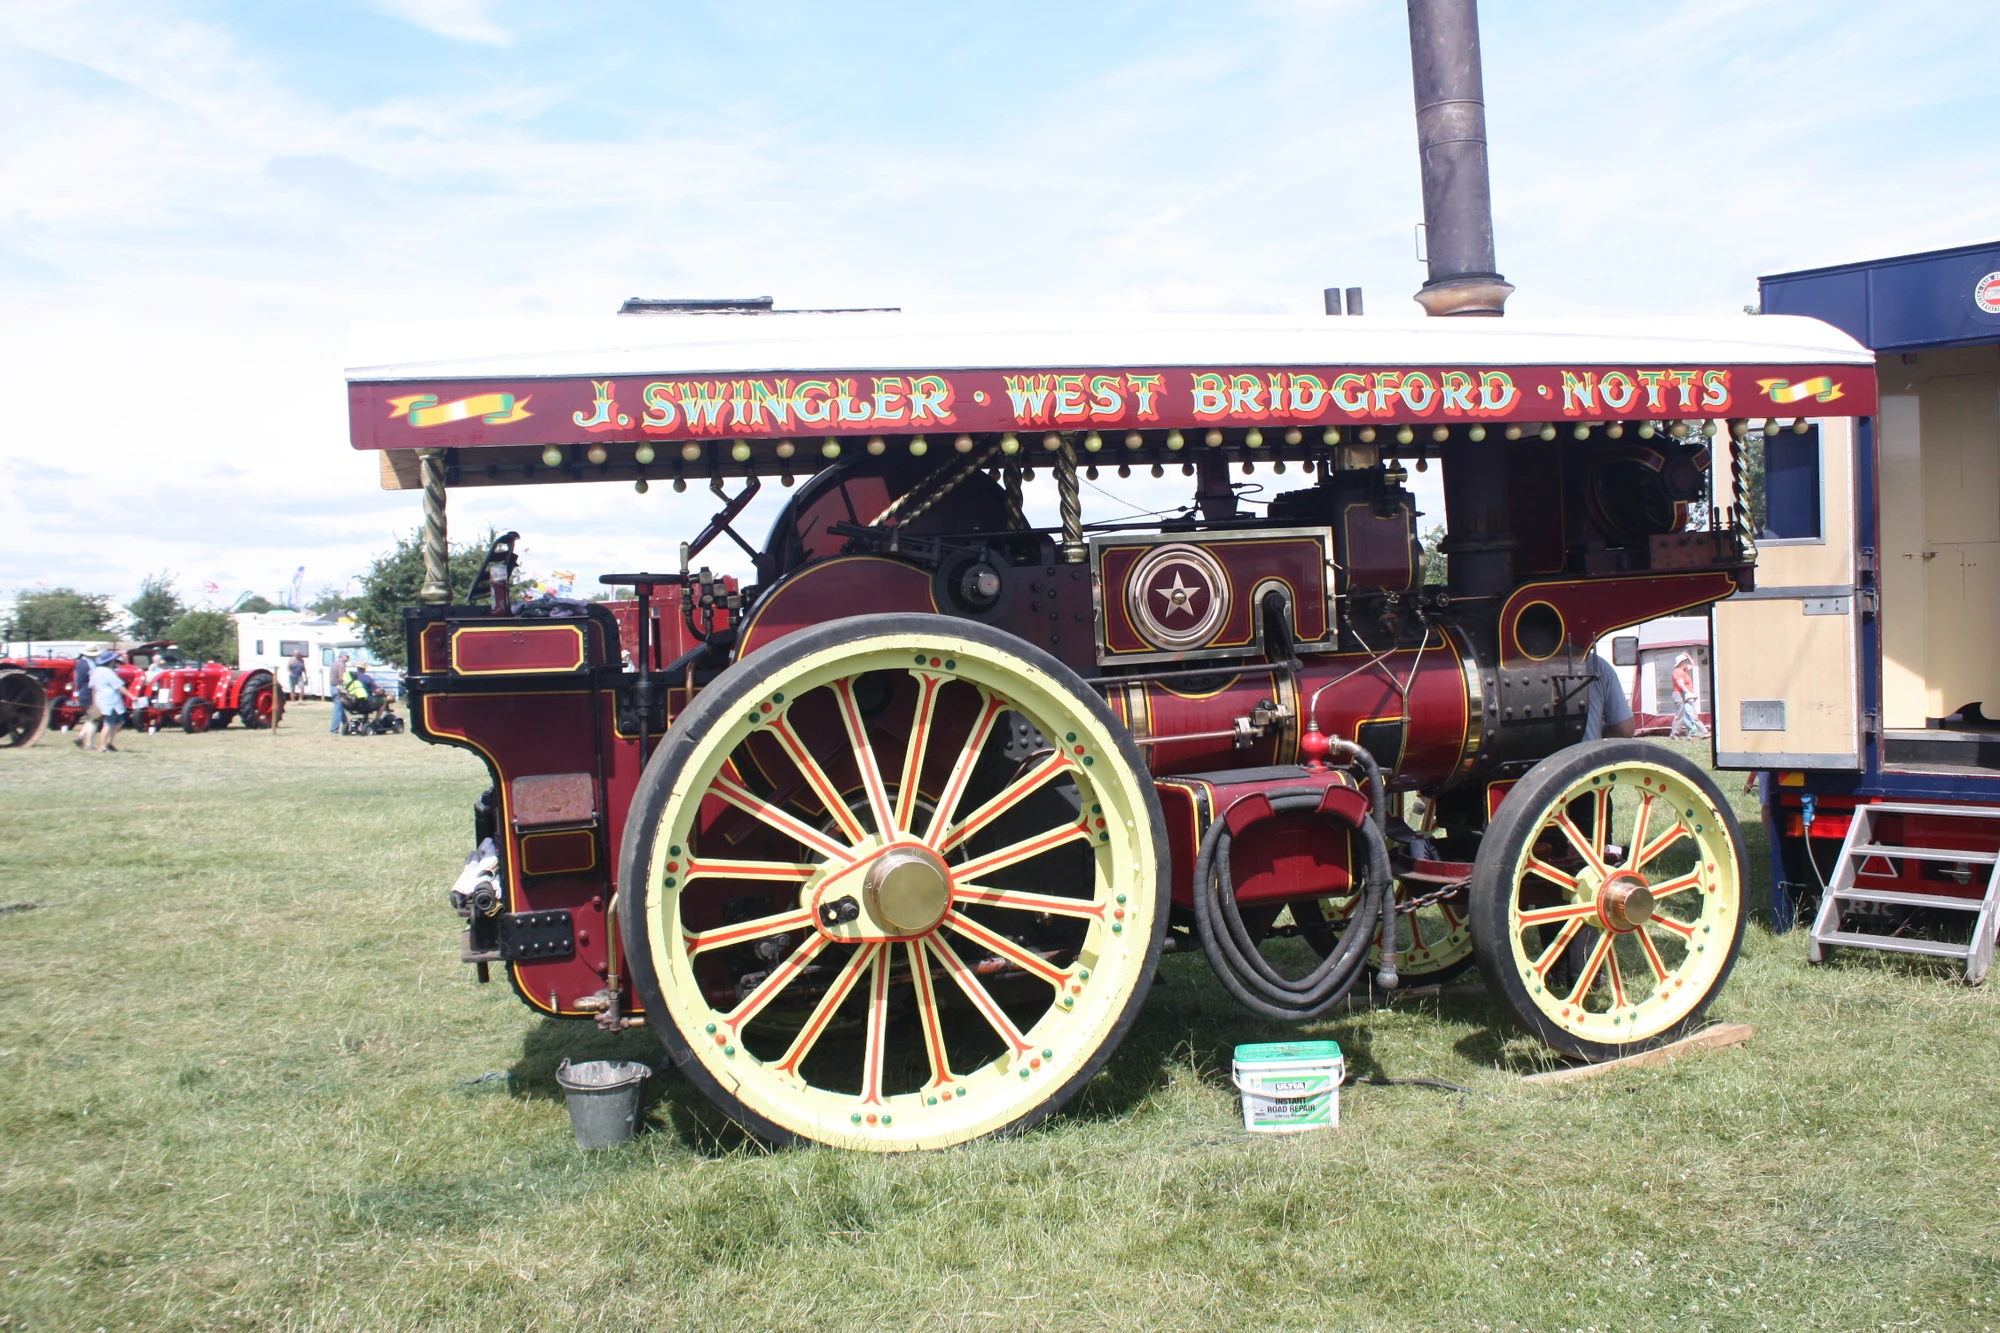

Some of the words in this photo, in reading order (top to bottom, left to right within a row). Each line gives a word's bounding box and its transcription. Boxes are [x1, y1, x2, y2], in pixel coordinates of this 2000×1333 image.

[573, 380, 632, 430] J.
[641, 376, 955, 432] SWINGLER
[1003, 373, 1164, 422] WEST
[1190, 371, 1519, 417] BRIDGFORD
[1561, 369, 1730, 413] NOTTS
[1276, 1082, 1305, 1090] ULTRA
[1275, 1097, 1306, 1105] INSTANT
[1267, 1105, 1288, 1113] ROAD
[1289, 1104, 1316, 1112] REPAIR
